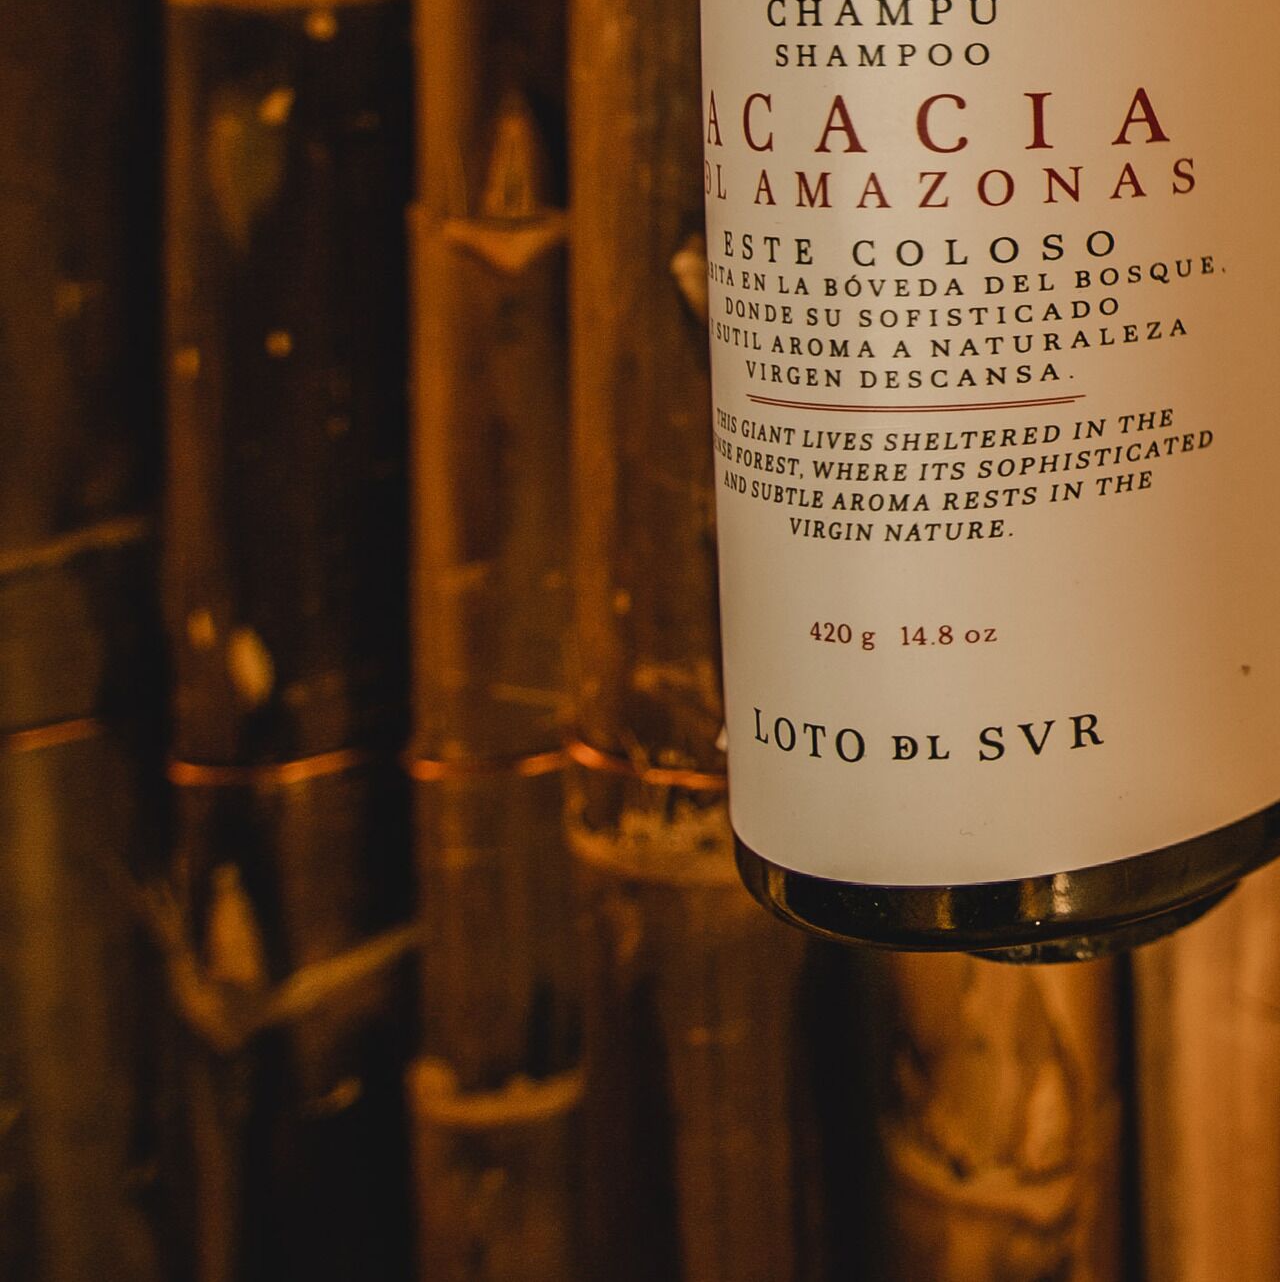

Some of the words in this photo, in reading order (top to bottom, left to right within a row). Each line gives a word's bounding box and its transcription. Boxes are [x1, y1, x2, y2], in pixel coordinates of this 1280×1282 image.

[775, 42, 991, 68] SHAMPOO
[707, 86, 1171, 154] ACACIA
[753, 157, 1196, 209] AMAZONAS
[723, 229, 814, 266] ESTE
[851, 230, 1116, 268] COLOSO
[741, 270, 767, 292] EN
[777, 275, 811, 296] LA
[823, 273, 965, 298] BÓVEDA
[983, 272, 1055, 295] DEL
[1074, 255, 1227, 289] BOSQUE.
[724, 295, 794, 325] DONDE
[806, 307, 842, 328] SU
[858, 296, 1119, 329] SOFISTICADO
[716, 321, 762, 351] SUTIL
[770, 334, 876, 359] AROMA
[891, 339, 913, 359] A
[929, 317, 1188, 358] NATURALEZA
[745, 359, 843, 388] VIRGEN
[858, 362, 1075, 390] DESCANSA.
[716, 407, 738, 435] THIS
[740, 419, 797, 446] GIANT
[801, 429, 874, 452] LIVES
[883, 424, 1061, 452] SHELTERED
[1071, 418, 1107, 441] IN
[1117, 407, 1174, 435] THE
[735, 445, 804, 480] FOREST,
[811, 459, 908, 482] WHERE
[918, 461, 966, 482] ITS
[977, 429, 1214, 479] SOPHISTICATED
[723, 469, 748, 495] AND
[750, 479, 824, 510] SUBTLE
[831, 491, 931, 513] AROMA
[941, 486, 1038, 511] RESTS
[1048, 480, 1085, 503] IN
[1095, 469, 1153, 497] THE
[788, 516, 875, 542] VIRGIN
[883, 518, 1014, 543] NATURE.
[809, 621, 853, 645] 420
[861, 630, 877, 652] g
[900, 624, 954, 647] 14.8
[964, 628, 998, 644] oz
[753, 706, 866, 764] LOTO
[978, 713, 1105, 762] SVR
